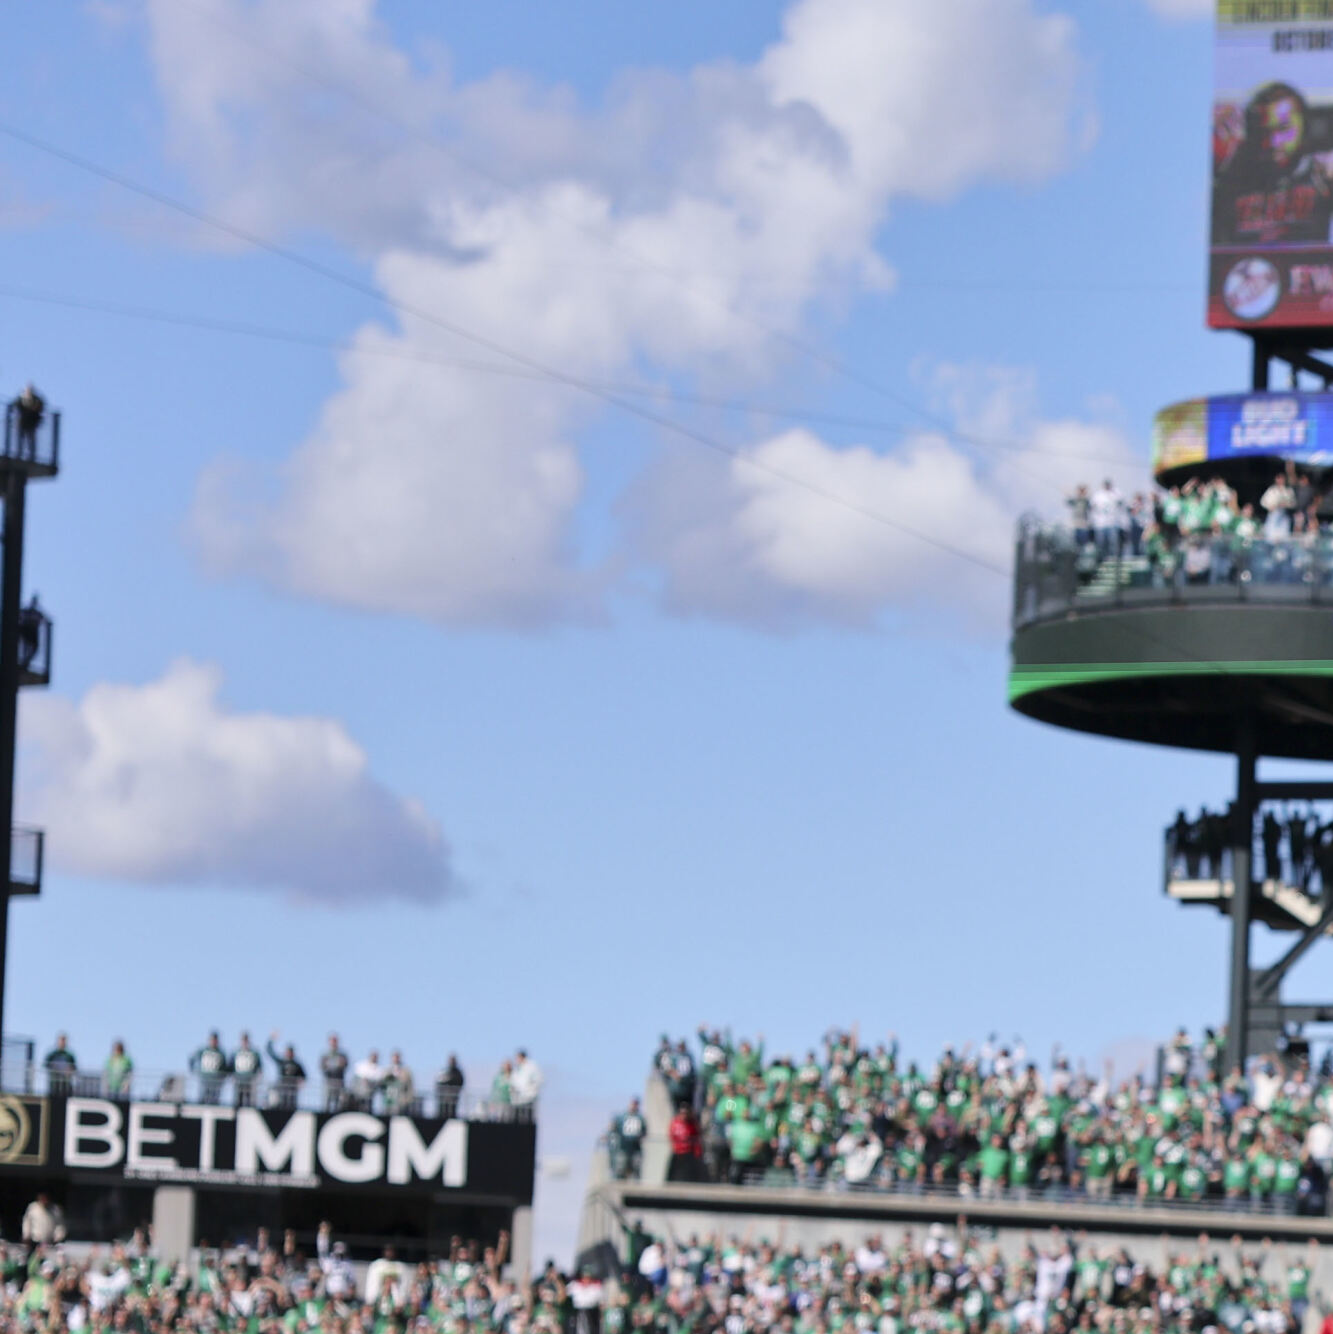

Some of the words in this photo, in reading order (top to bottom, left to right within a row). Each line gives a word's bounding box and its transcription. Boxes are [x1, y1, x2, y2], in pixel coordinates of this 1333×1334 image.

[1241, 399, 1299, 424] BUD
[1230, 422, 1307, 448] LIGHT
[63, 1097, 468, 1188] BETMGM
